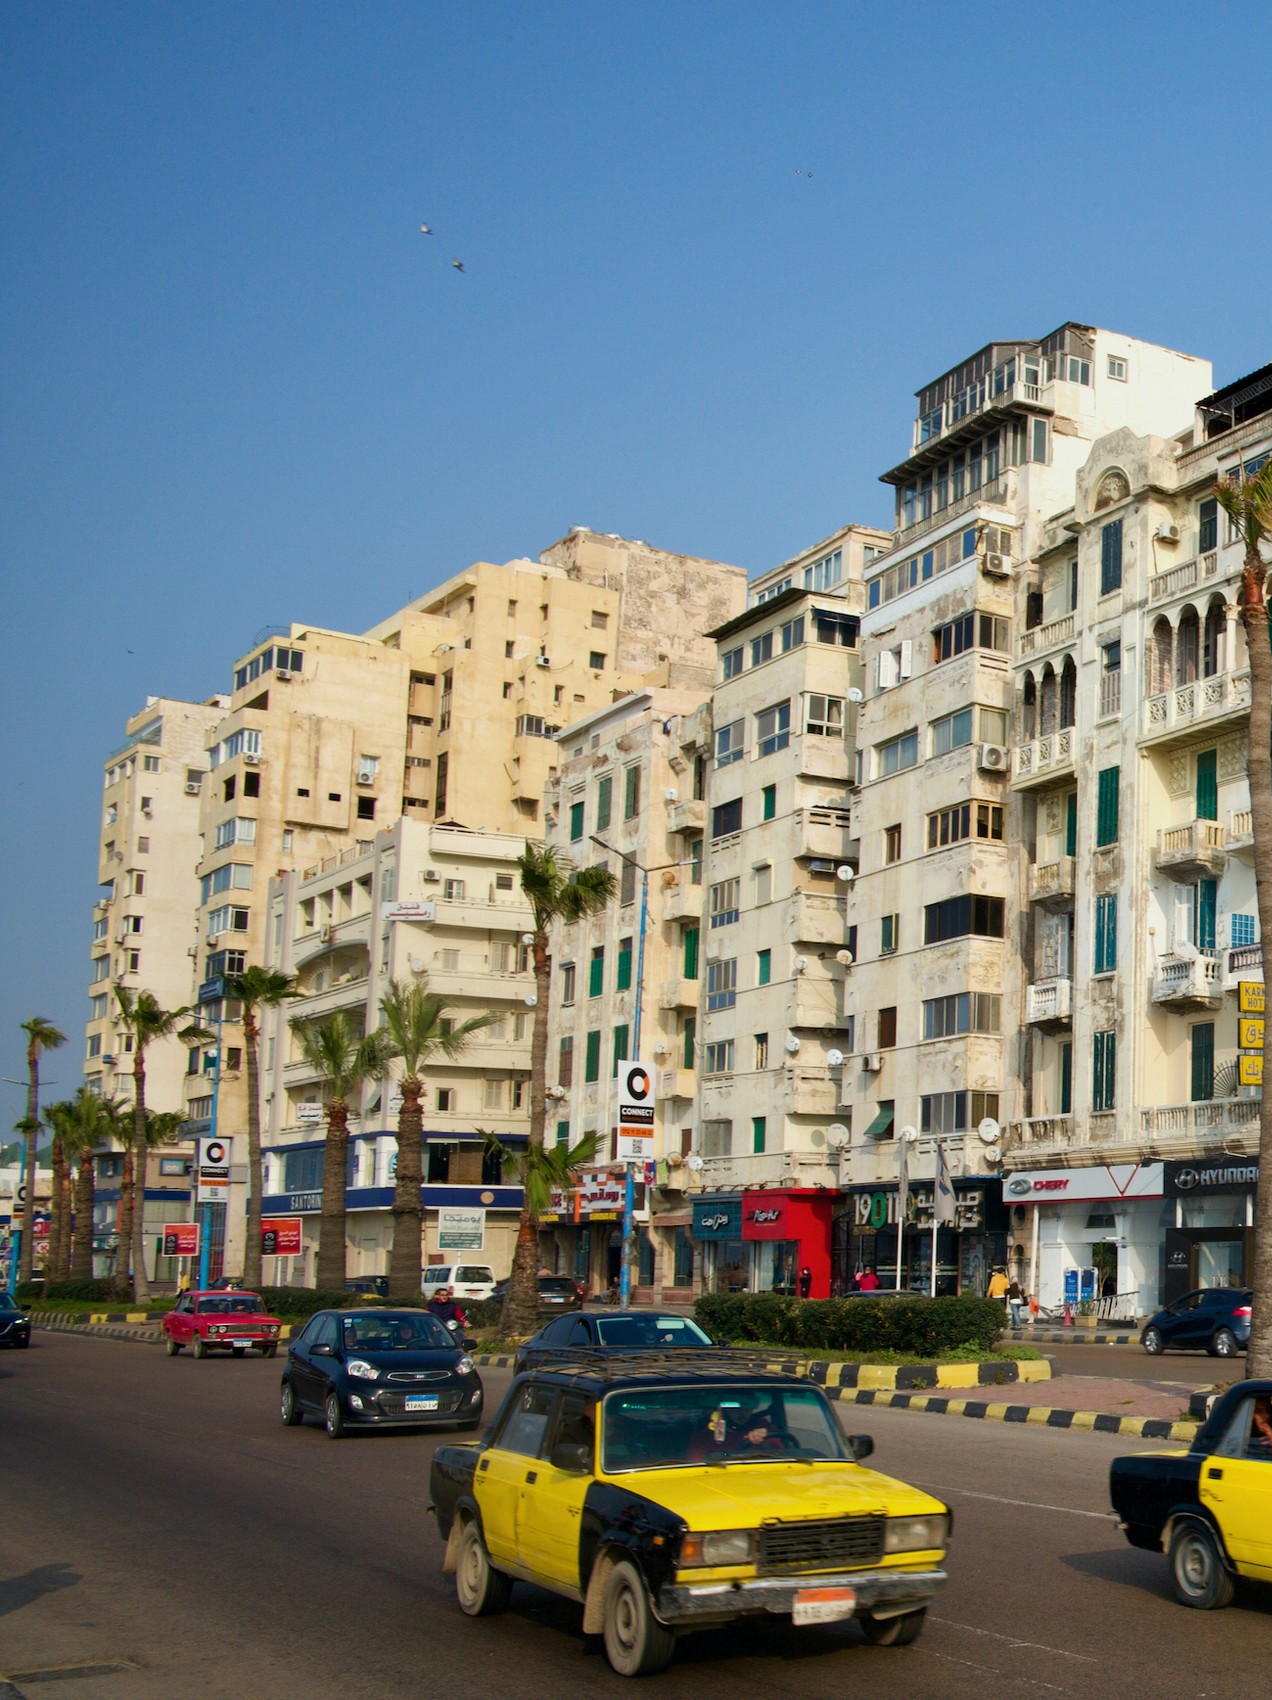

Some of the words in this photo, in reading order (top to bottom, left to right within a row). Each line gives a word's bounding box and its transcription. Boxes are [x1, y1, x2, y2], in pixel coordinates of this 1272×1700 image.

[621, 1107, 654, 1117] CONNECT
[1033, 1178, 1070, 1192] CHERY
[853, 1191, 900, 1229] 19011
